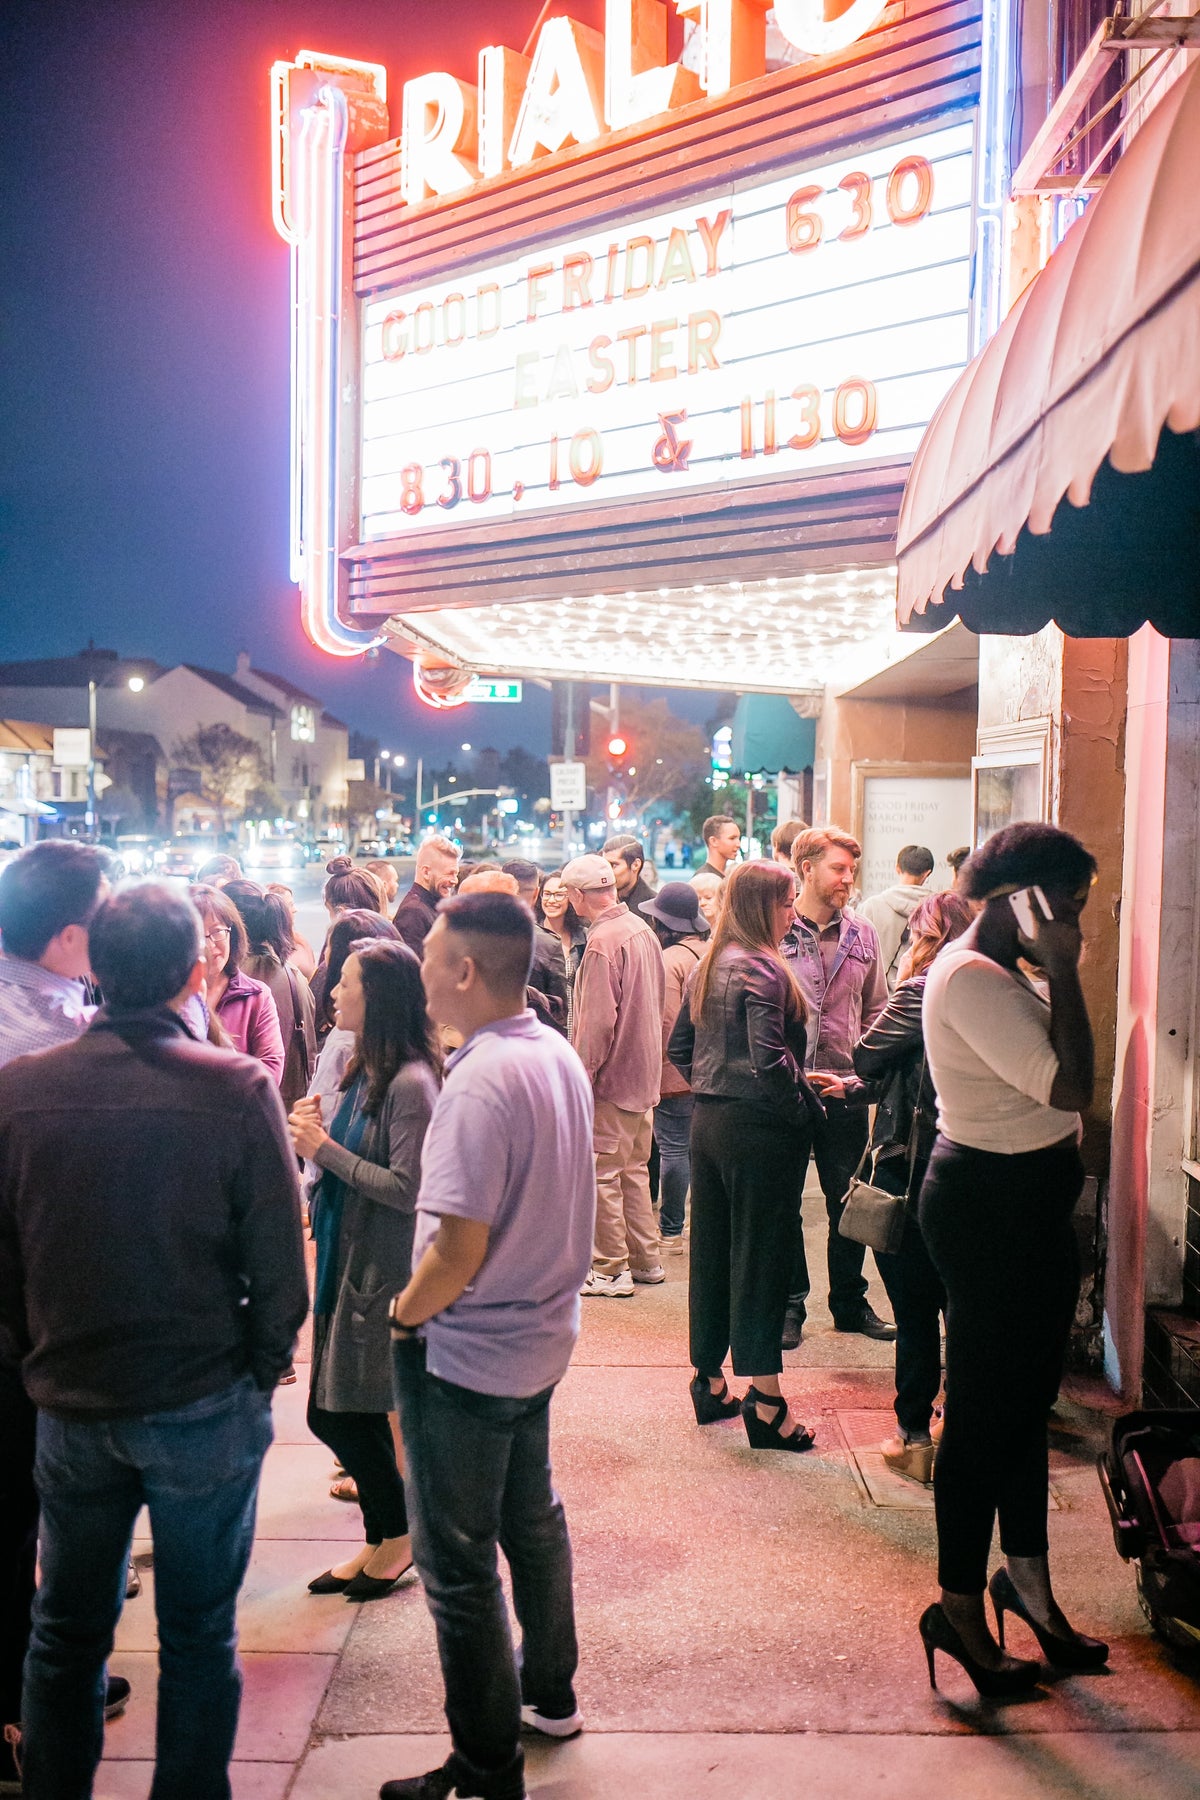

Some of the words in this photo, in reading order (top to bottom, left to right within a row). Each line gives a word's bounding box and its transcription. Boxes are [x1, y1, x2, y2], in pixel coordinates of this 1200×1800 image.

[382, 281, 501, 362] GOOD
[526, 208, 733, 324] FRIDAY
[785, 155, 935, 254] 630
[512, 309, 721, 410] EASTER
[549, 427, 603, 491] 10
[651, 408, 694, 473] &
[739, 375, 878, 460] 1130
[868, 801, 901, 811] GOOD
[904, 801, 940, 811] FRIDAY
[868, 812, 908, 822] MARCH
